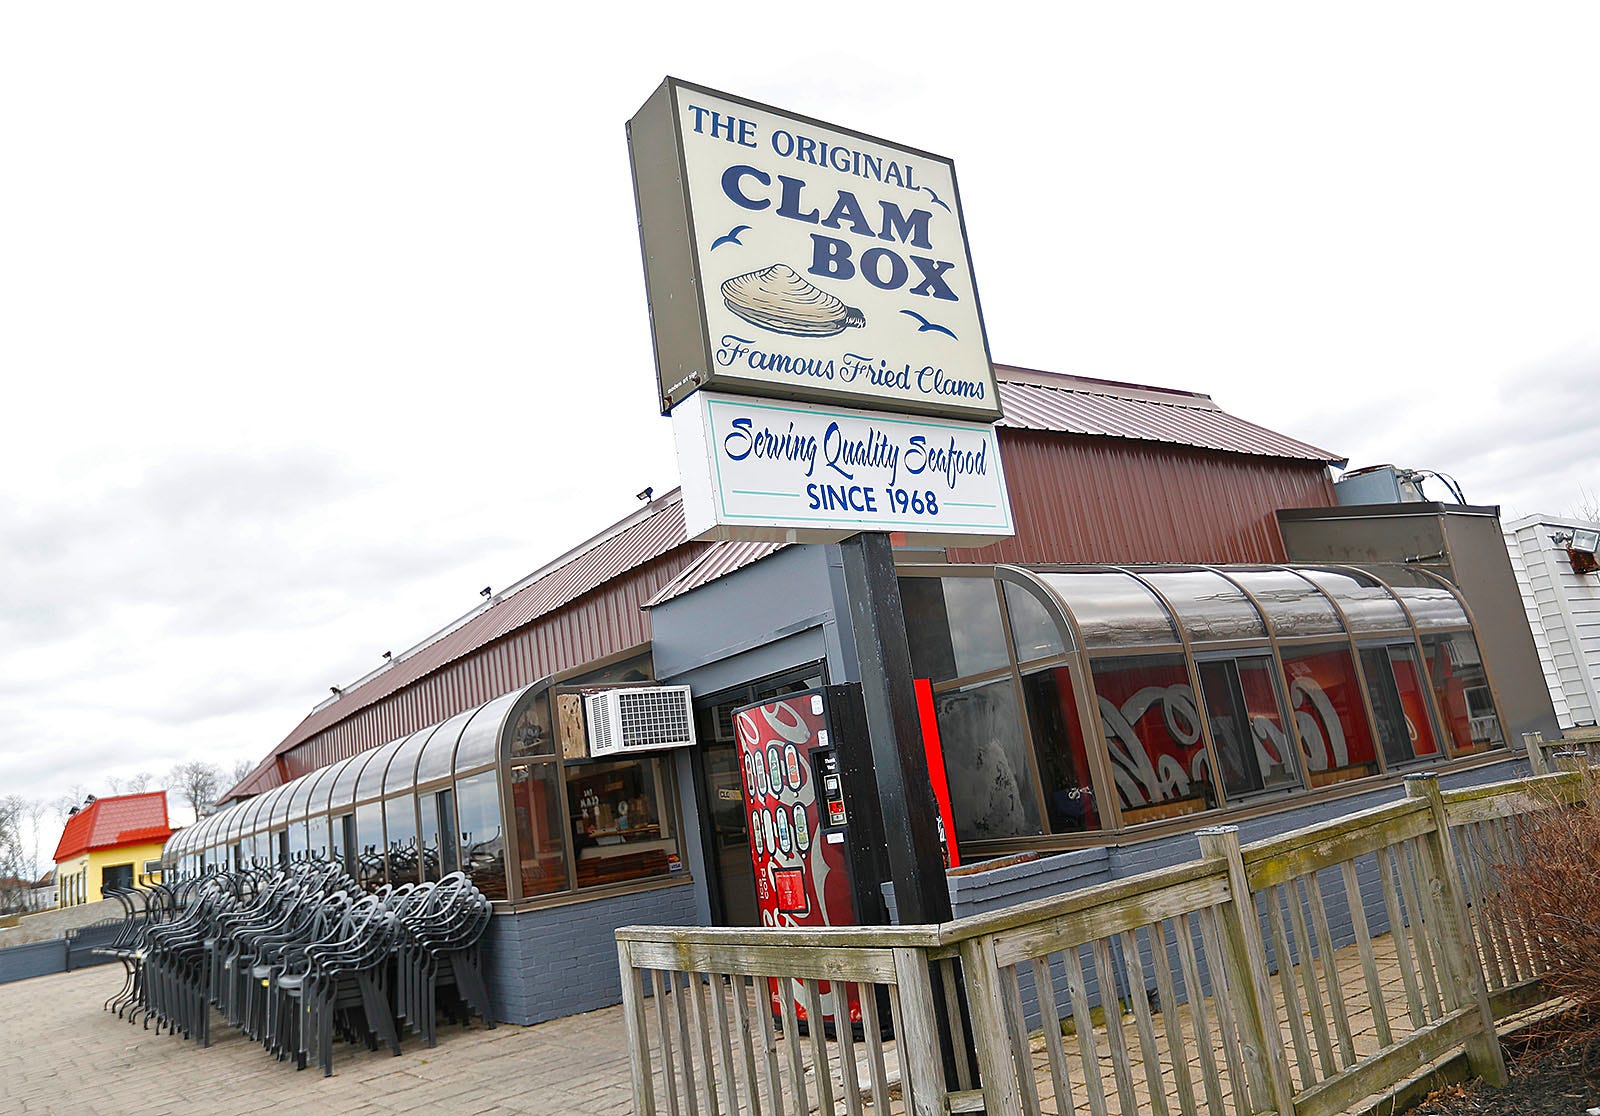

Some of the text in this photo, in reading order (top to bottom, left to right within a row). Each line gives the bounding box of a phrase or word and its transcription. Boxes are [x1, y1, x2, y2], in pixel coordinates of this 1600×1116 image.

[688, 104, 920, 191] THE ORIGINAL
[721, 165, 932, 249] CLAM
[807, 233, 959, 301] BOX
[716, 335, 985, 400] Famous Fried Clams
[724, 418, 987, 488] Serving Quality Seafood
[806, 483, 939, 516] SINCE 1968
